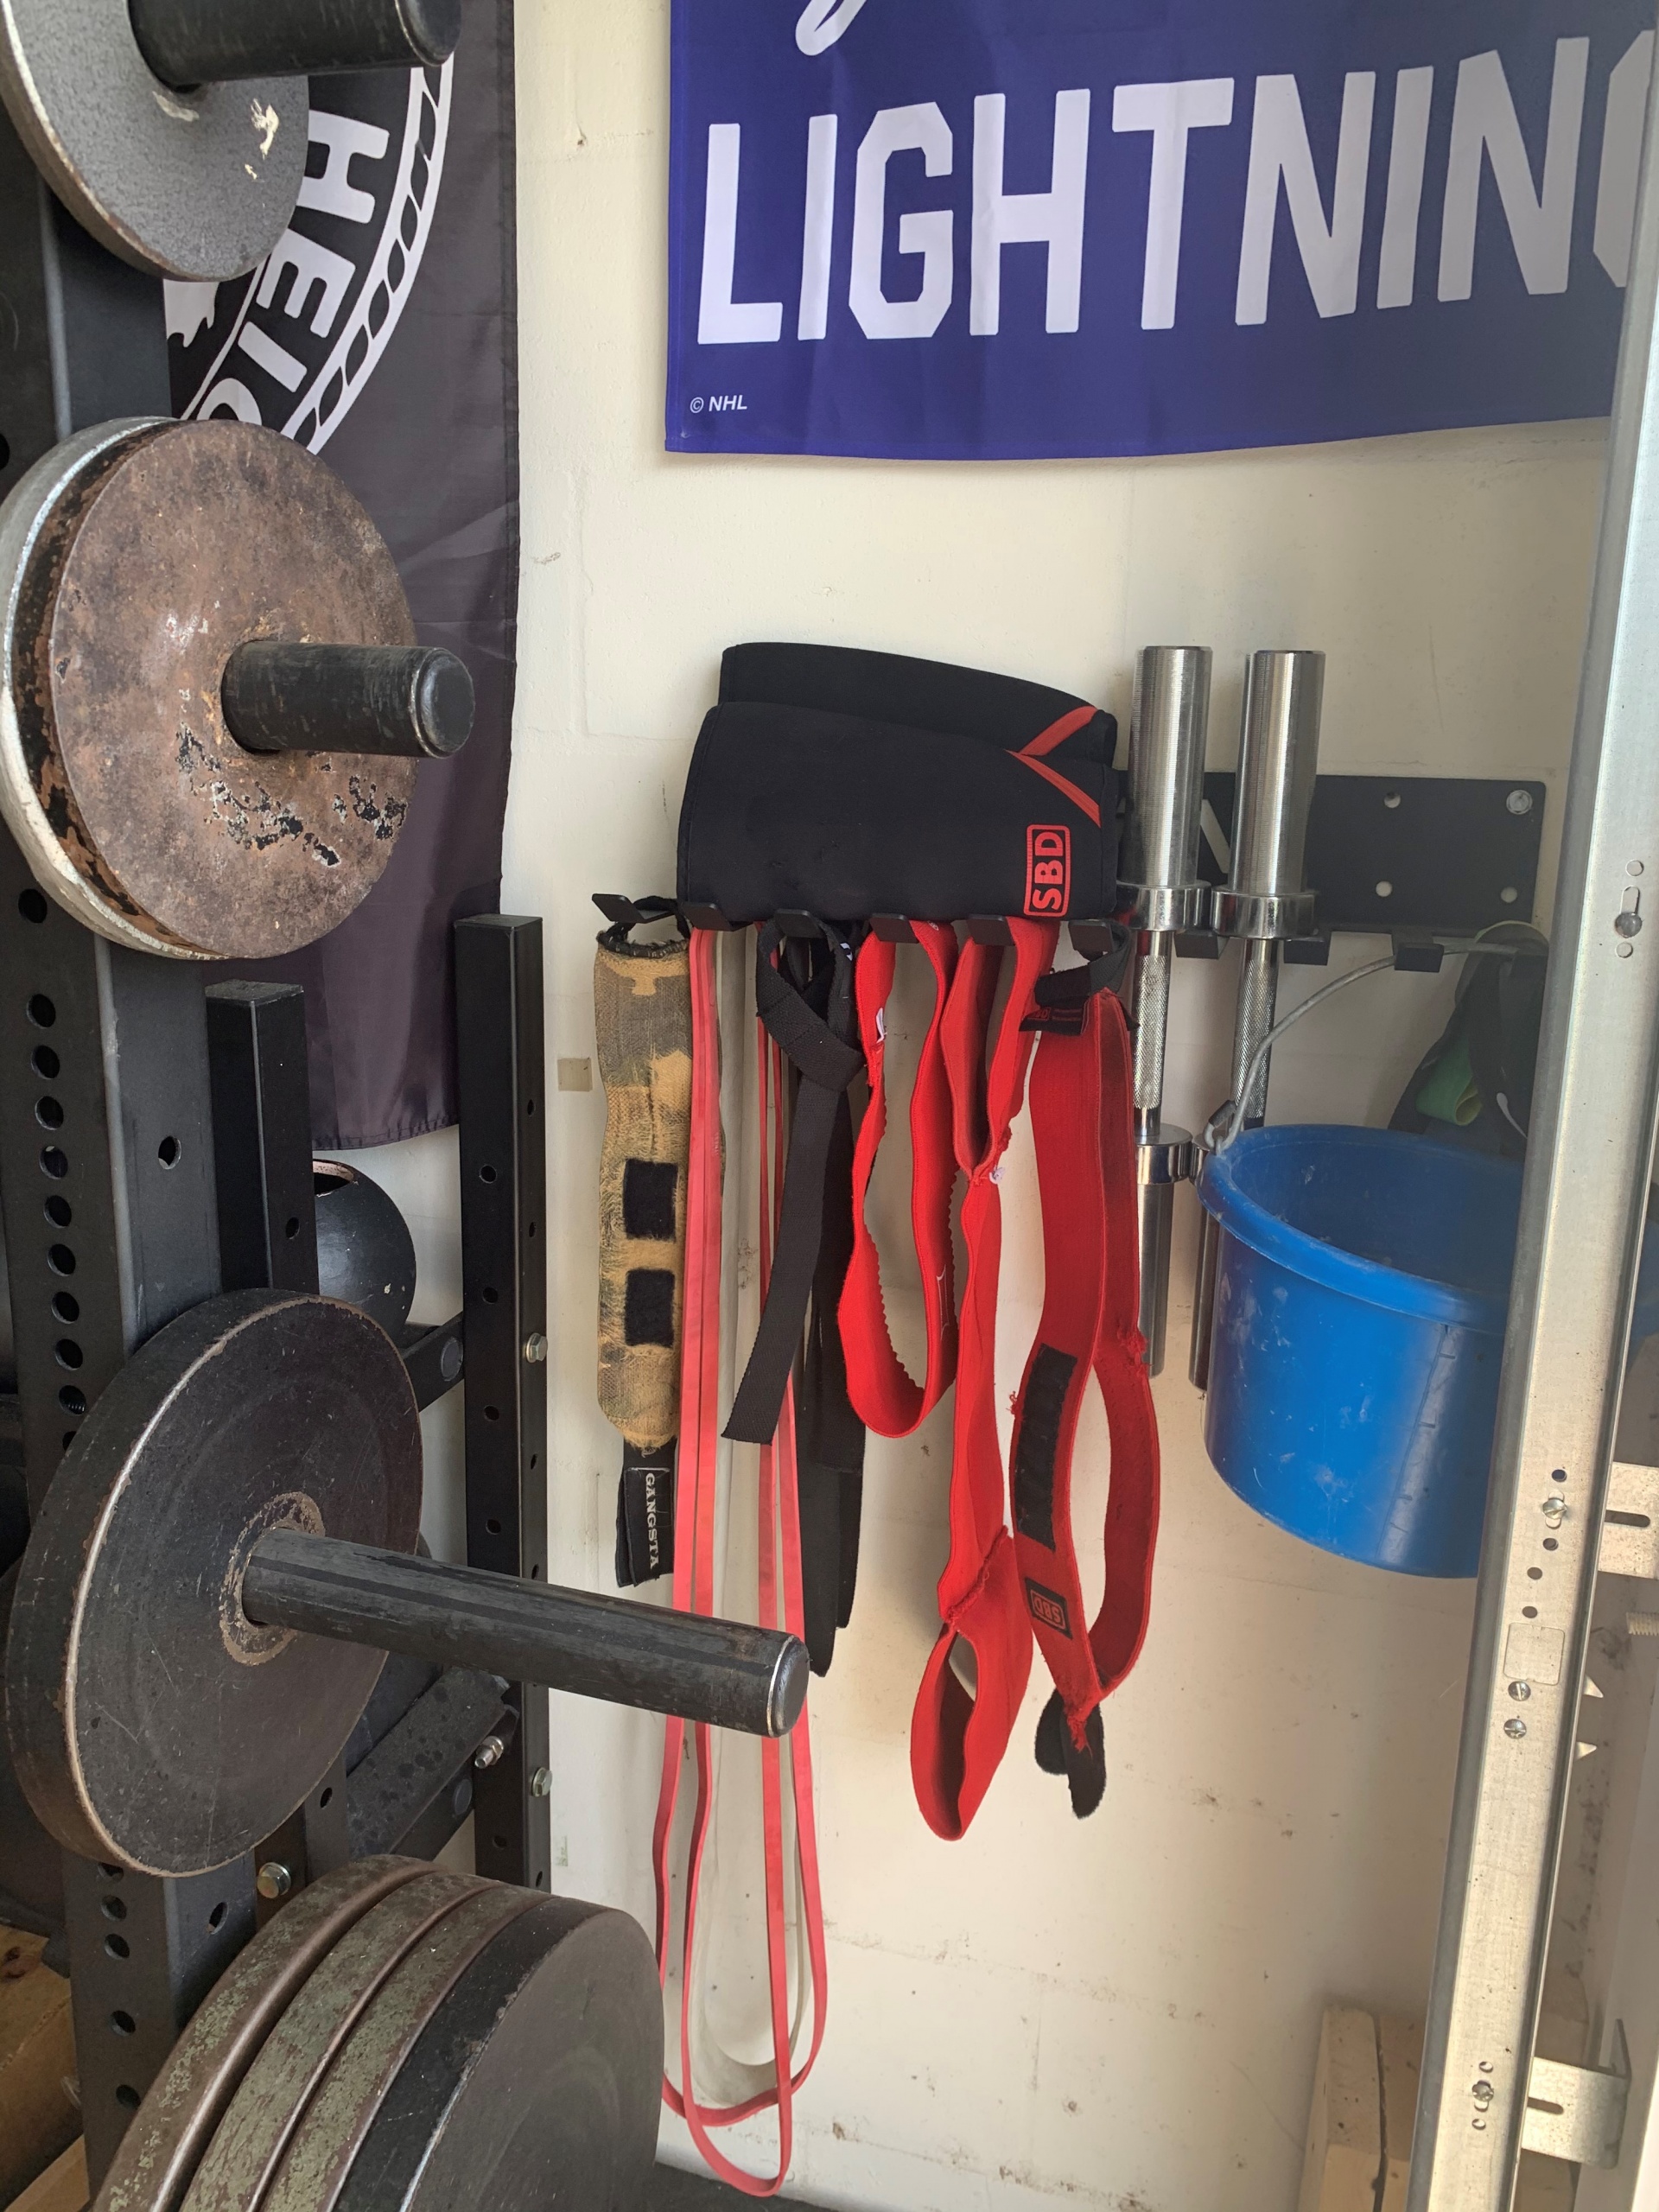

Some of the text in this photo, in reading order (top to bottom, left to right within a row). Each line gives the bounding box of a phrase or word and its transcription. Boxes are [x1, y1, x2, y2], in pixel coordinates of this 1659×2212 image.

[709, 394, 748, 412] NHL
[1032, 831, 1064, 911] SBD
[645, 1472, 659, 1570] GANGSTA
[1033, 1596, 1061, 1623] SBD
